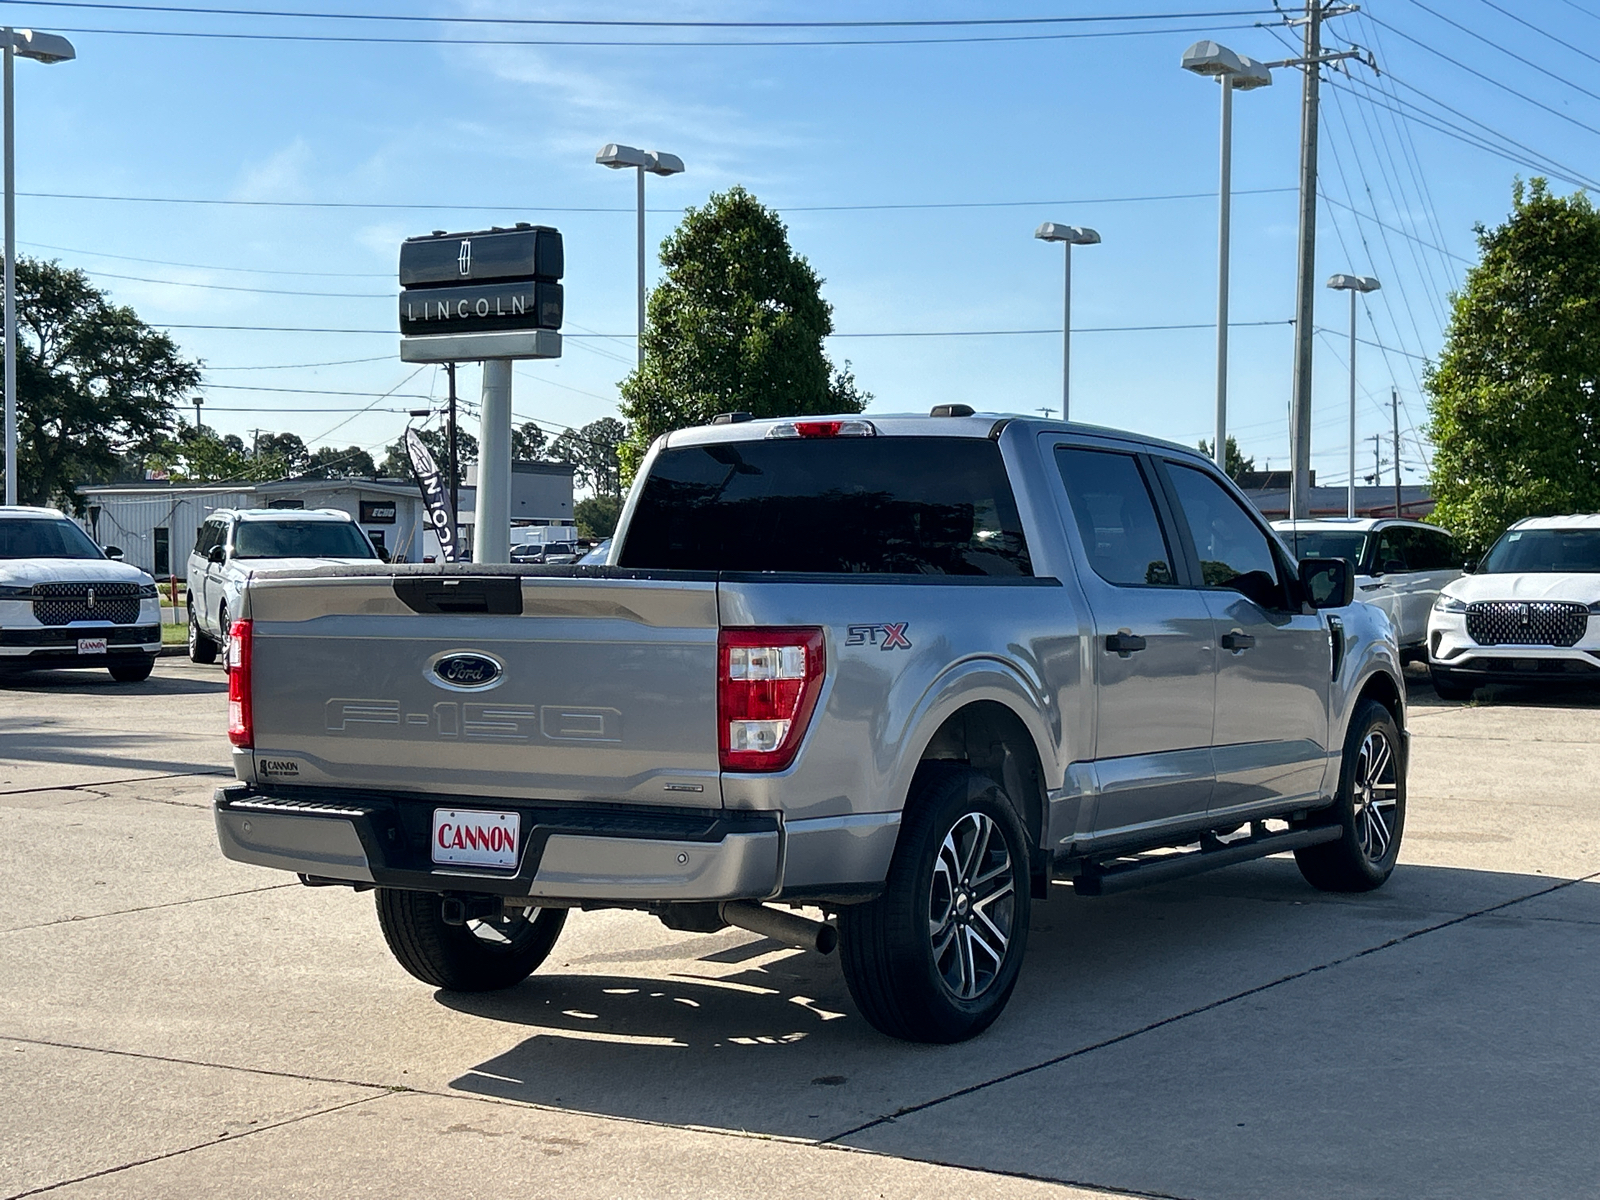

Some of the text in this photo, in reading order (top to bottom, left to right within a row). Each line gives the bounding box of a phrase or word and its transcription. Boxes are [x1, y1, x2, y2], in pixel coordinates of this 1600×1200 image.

[408, 295, 525, 321] LINCOLN
[372, 508, 395, 517] ECHO
[423, 477, 455, 561] NCOLN
[80, 642, 105, 650] CANNON
[845, 622, 912, 651] STX
[447, 659, 484, 680] Ford
[325, 698, 622, 743] F-150
[267, 761, 298, 771] CANNON
[438, 823, 516, 853] CANNON
